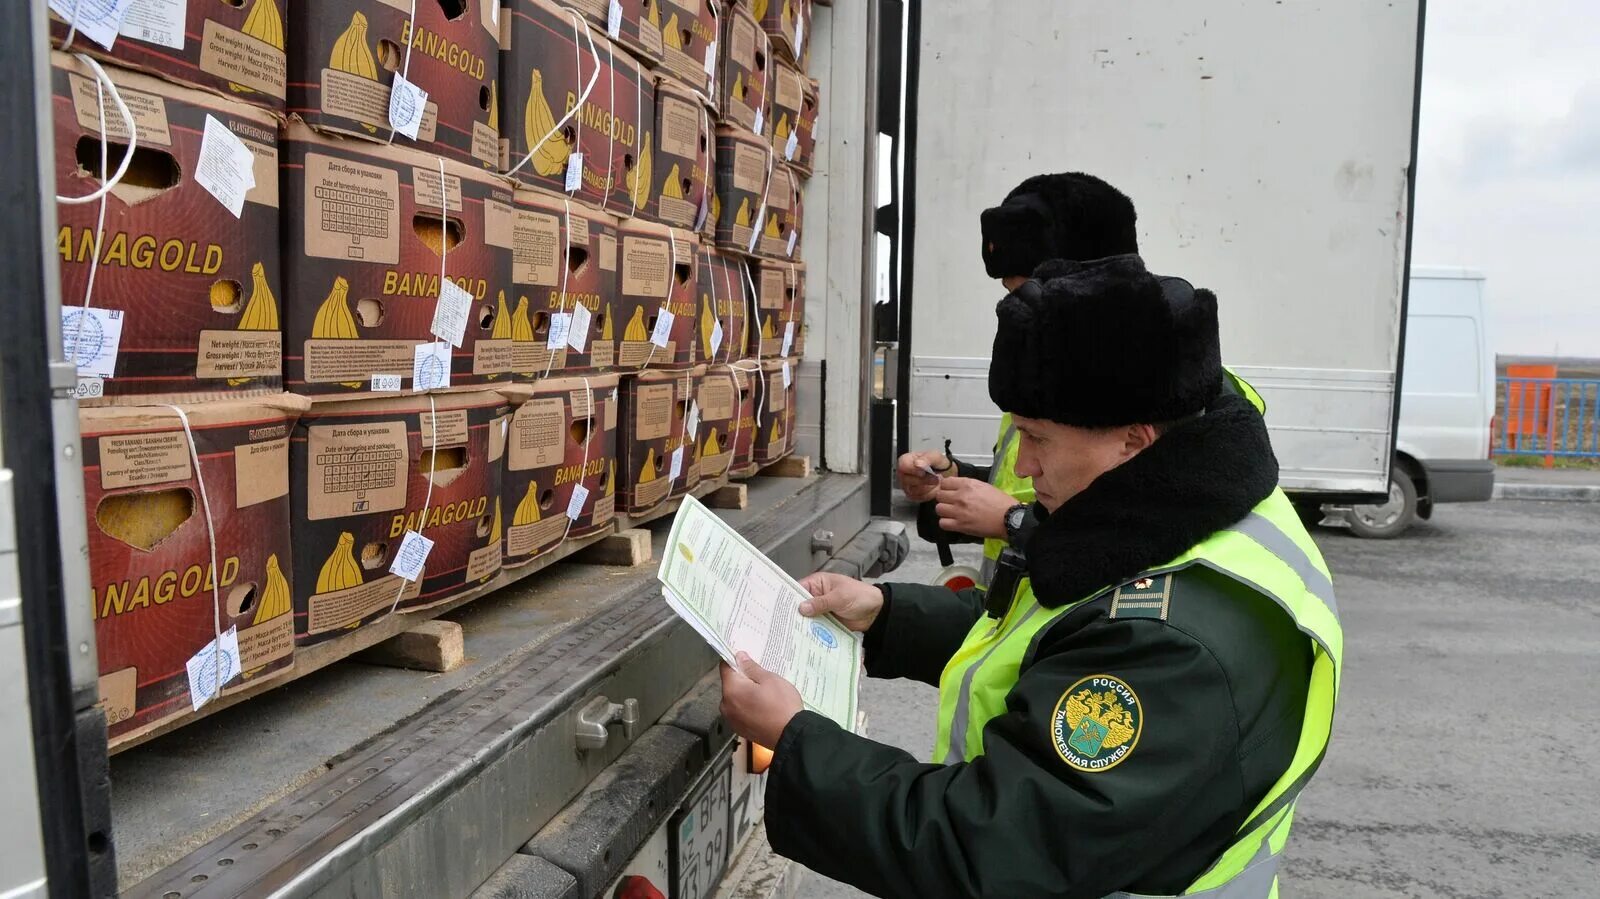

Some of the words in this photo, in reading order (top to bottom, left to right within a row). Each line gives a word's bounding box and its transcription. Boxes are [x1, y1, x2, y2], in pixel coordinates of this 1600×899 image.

[210, 42, 224, 54] Gross
[218, 58, 237, 70] Harvest
[328, 162, 340, 171] Дата
[342, 165, 356, 175] сбора
[339, 182, 360, 193] harvesting
[56, 226, 223, 274] ANAGOLD
[383, 271, 487, 300] BANAOLD
[211, 340, 221, 348] Net
[222, 341, 239, 349] weight
[222, 351, 239, 360] weight
[347, 429, 362, 437] сбора
[390, 496, 488, 538] BANAGOLD
[92, 556, 240, 620] NAGOLD
[1092, 678, 1136, 706] РОССИЯ
[1055, 710, 1088, 768] ТАМОЖЕННАЯ
[1090, 744, 1130, 768] СЛУЖБА
[701, 775, 726, 832] BFA
[706, 829, 722, 884] 99
